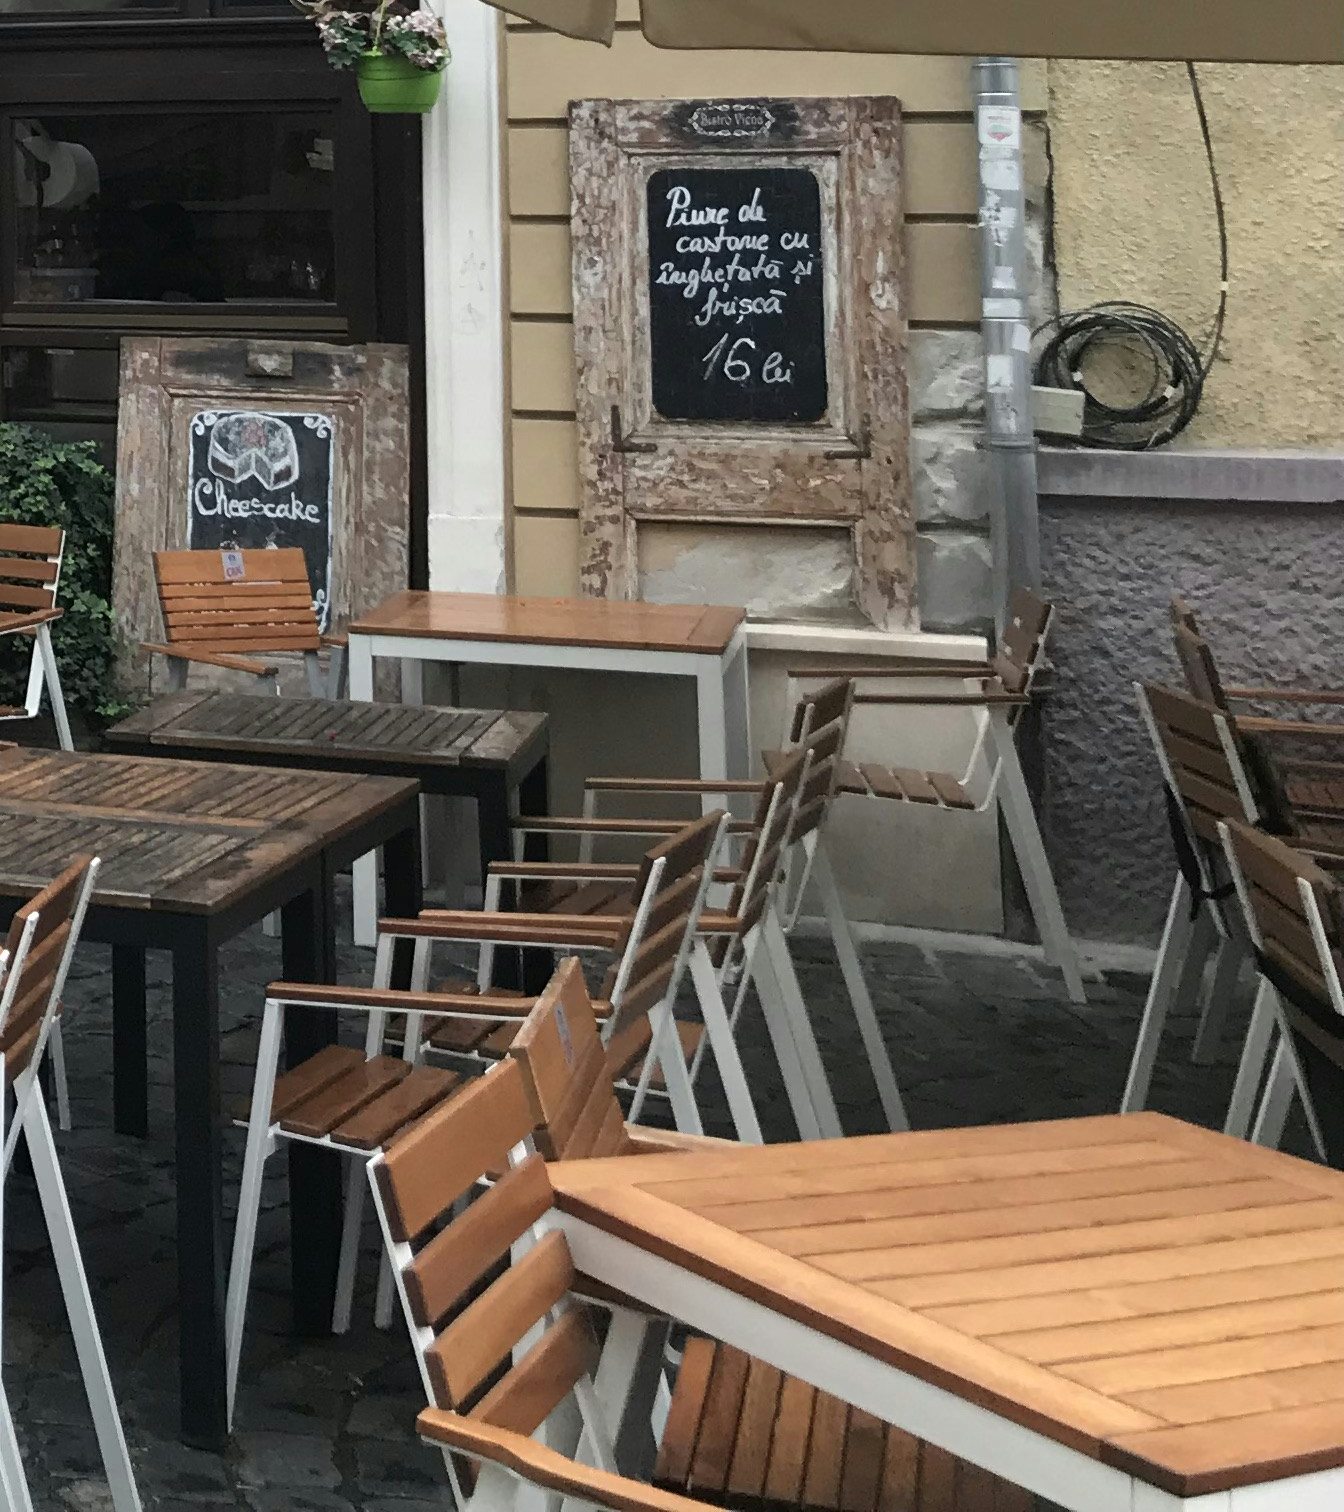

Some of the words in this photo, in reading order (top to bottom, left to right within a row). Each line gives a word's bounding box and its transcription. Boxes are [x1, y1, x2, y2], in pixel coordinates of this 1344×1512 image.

[738, 187, 767, 222] de
[675, 226, 770, 253] castane
[780, 232, 809, 250] cu
[702, 332, 756, 381] 16
[762, 351, 796, 383] lei
